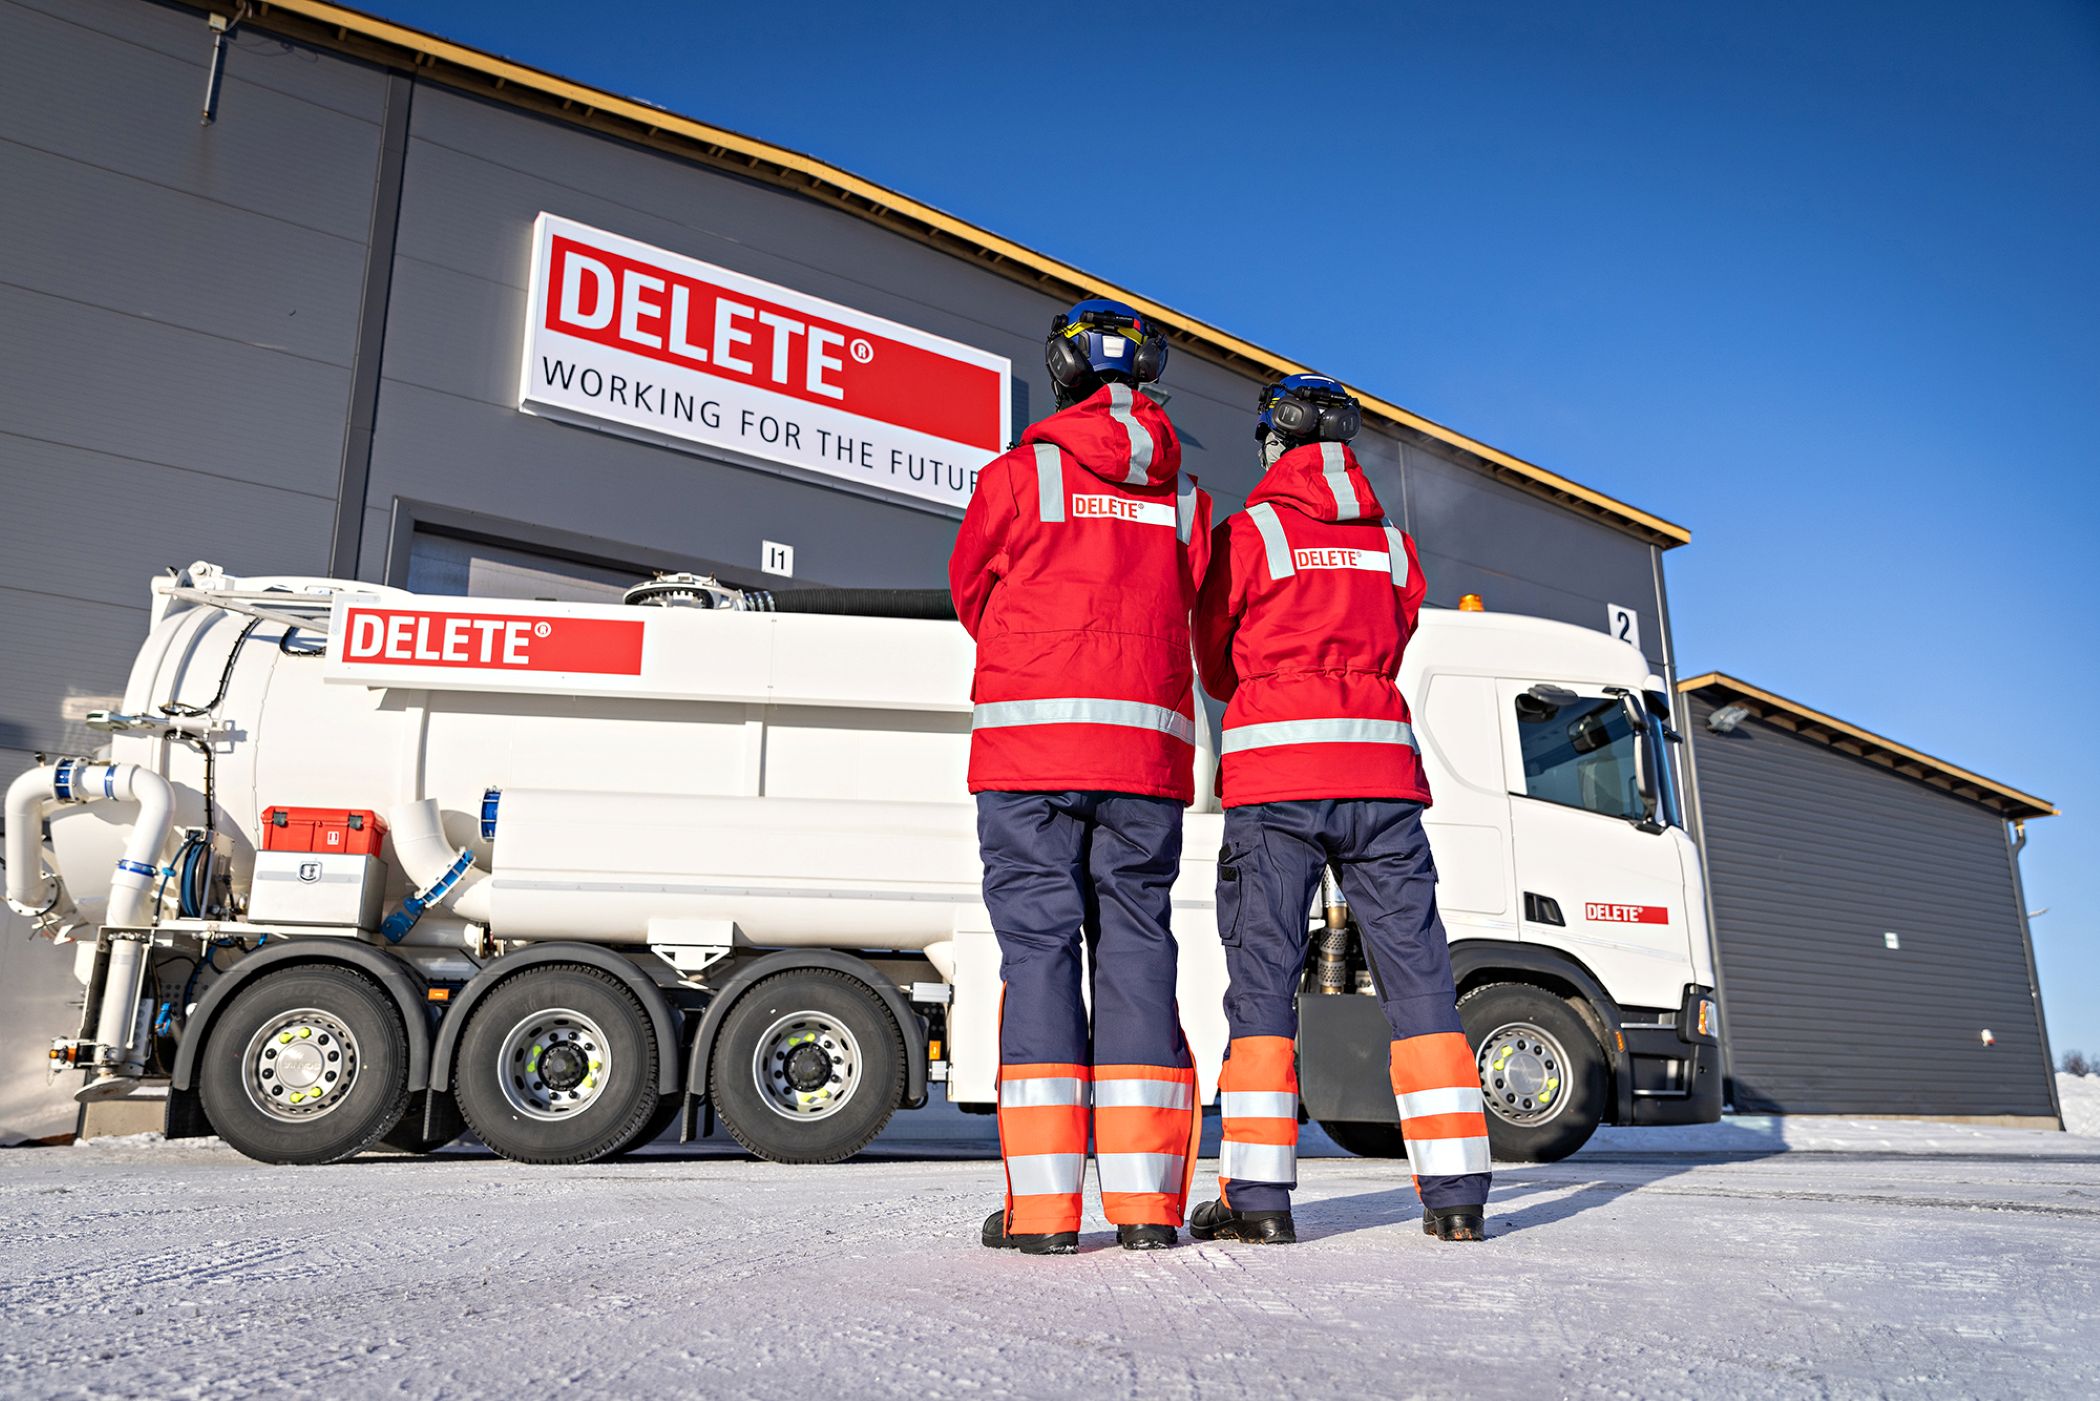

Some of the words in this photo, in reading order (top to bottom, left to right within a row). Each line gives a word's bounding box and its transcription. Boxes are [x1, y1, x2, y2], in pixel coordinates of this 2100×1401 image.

[543, 356, 720, 428] WORKING
[741, 410, 801, 450] FOR
[816, 429, 873, 469] THE
[1617, 611, 1632, 645] 2
